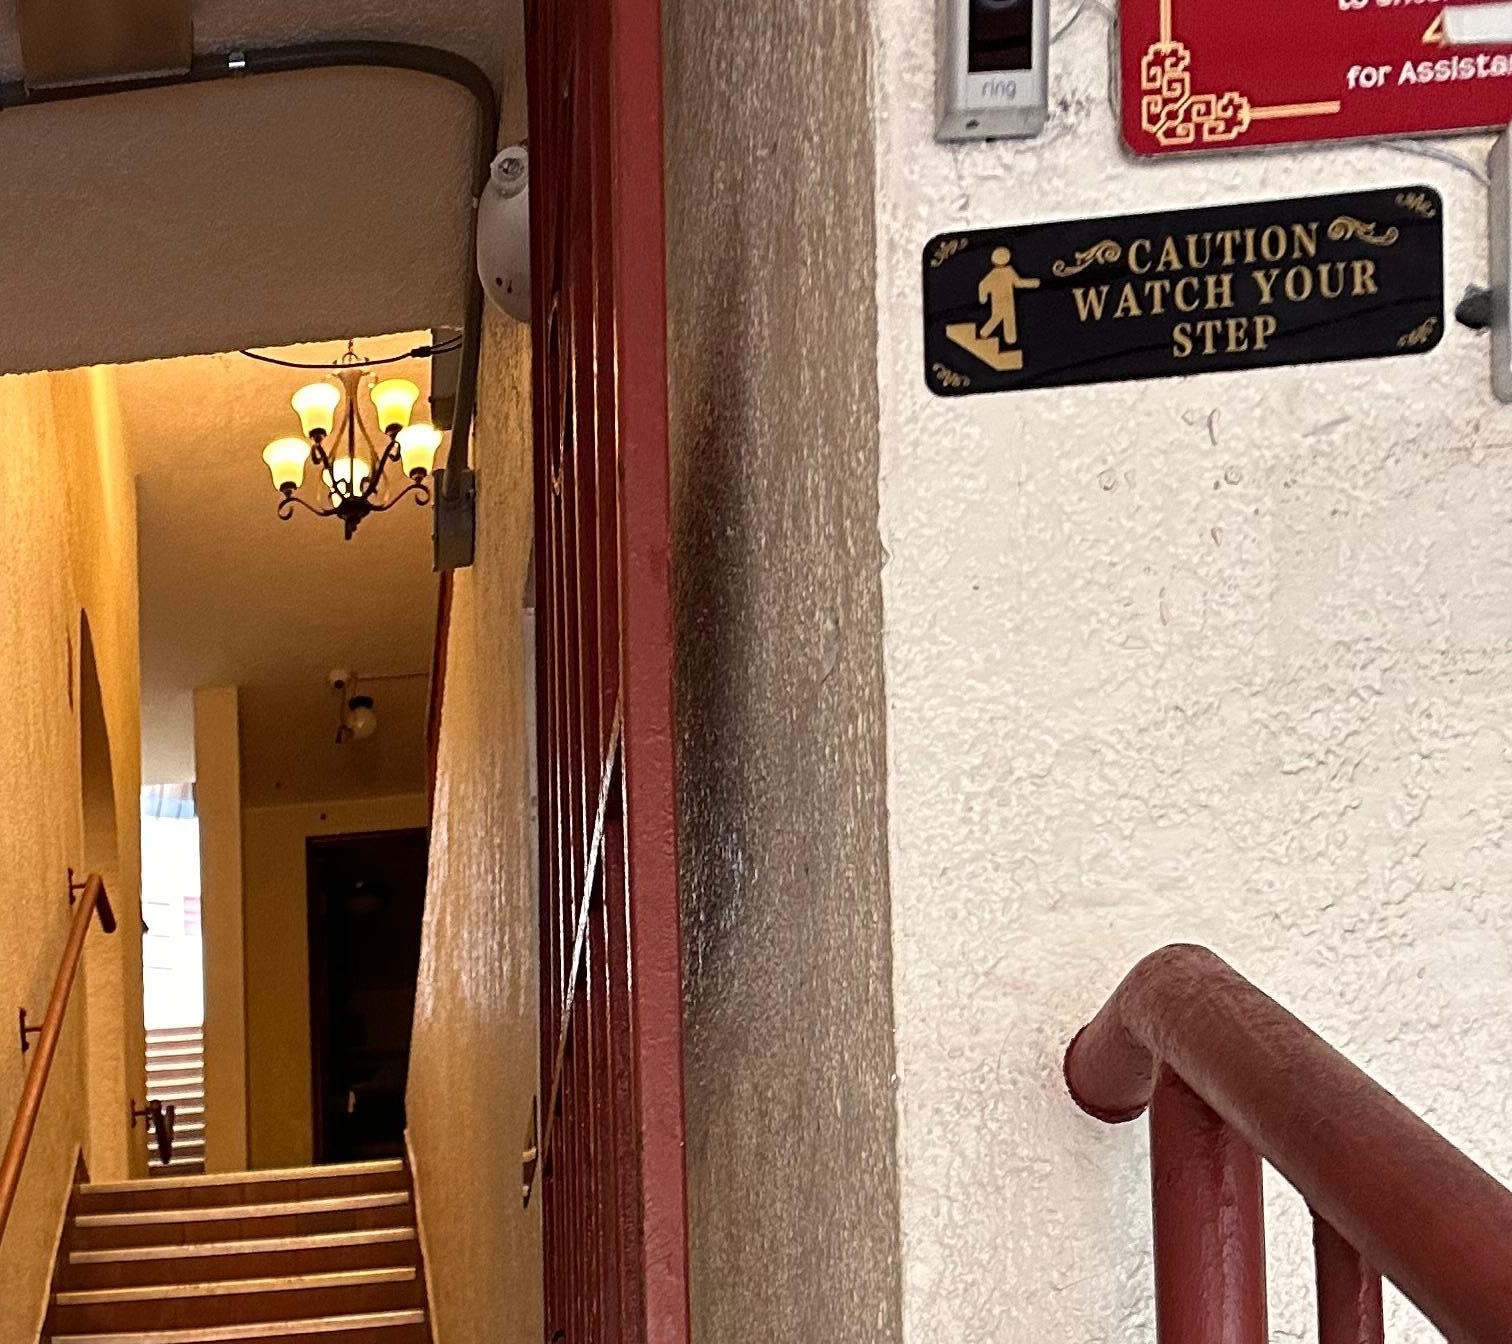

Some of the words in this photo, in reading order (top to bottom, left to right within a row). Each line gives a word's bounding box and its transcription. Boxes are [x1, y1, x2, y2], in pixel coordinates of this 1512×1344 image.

[982, 77, 1016, 100] ring
[1346, 64, 1392, 89] for
[1397, 53, 1512, 86] Assista
[1127, 222, 1320, 275] CAUTION
[1072, 272, 1235, 322] WATCH
[1251, 259, 1378, 305] YOUR
[1172, 314, 1277, 358] STEP
